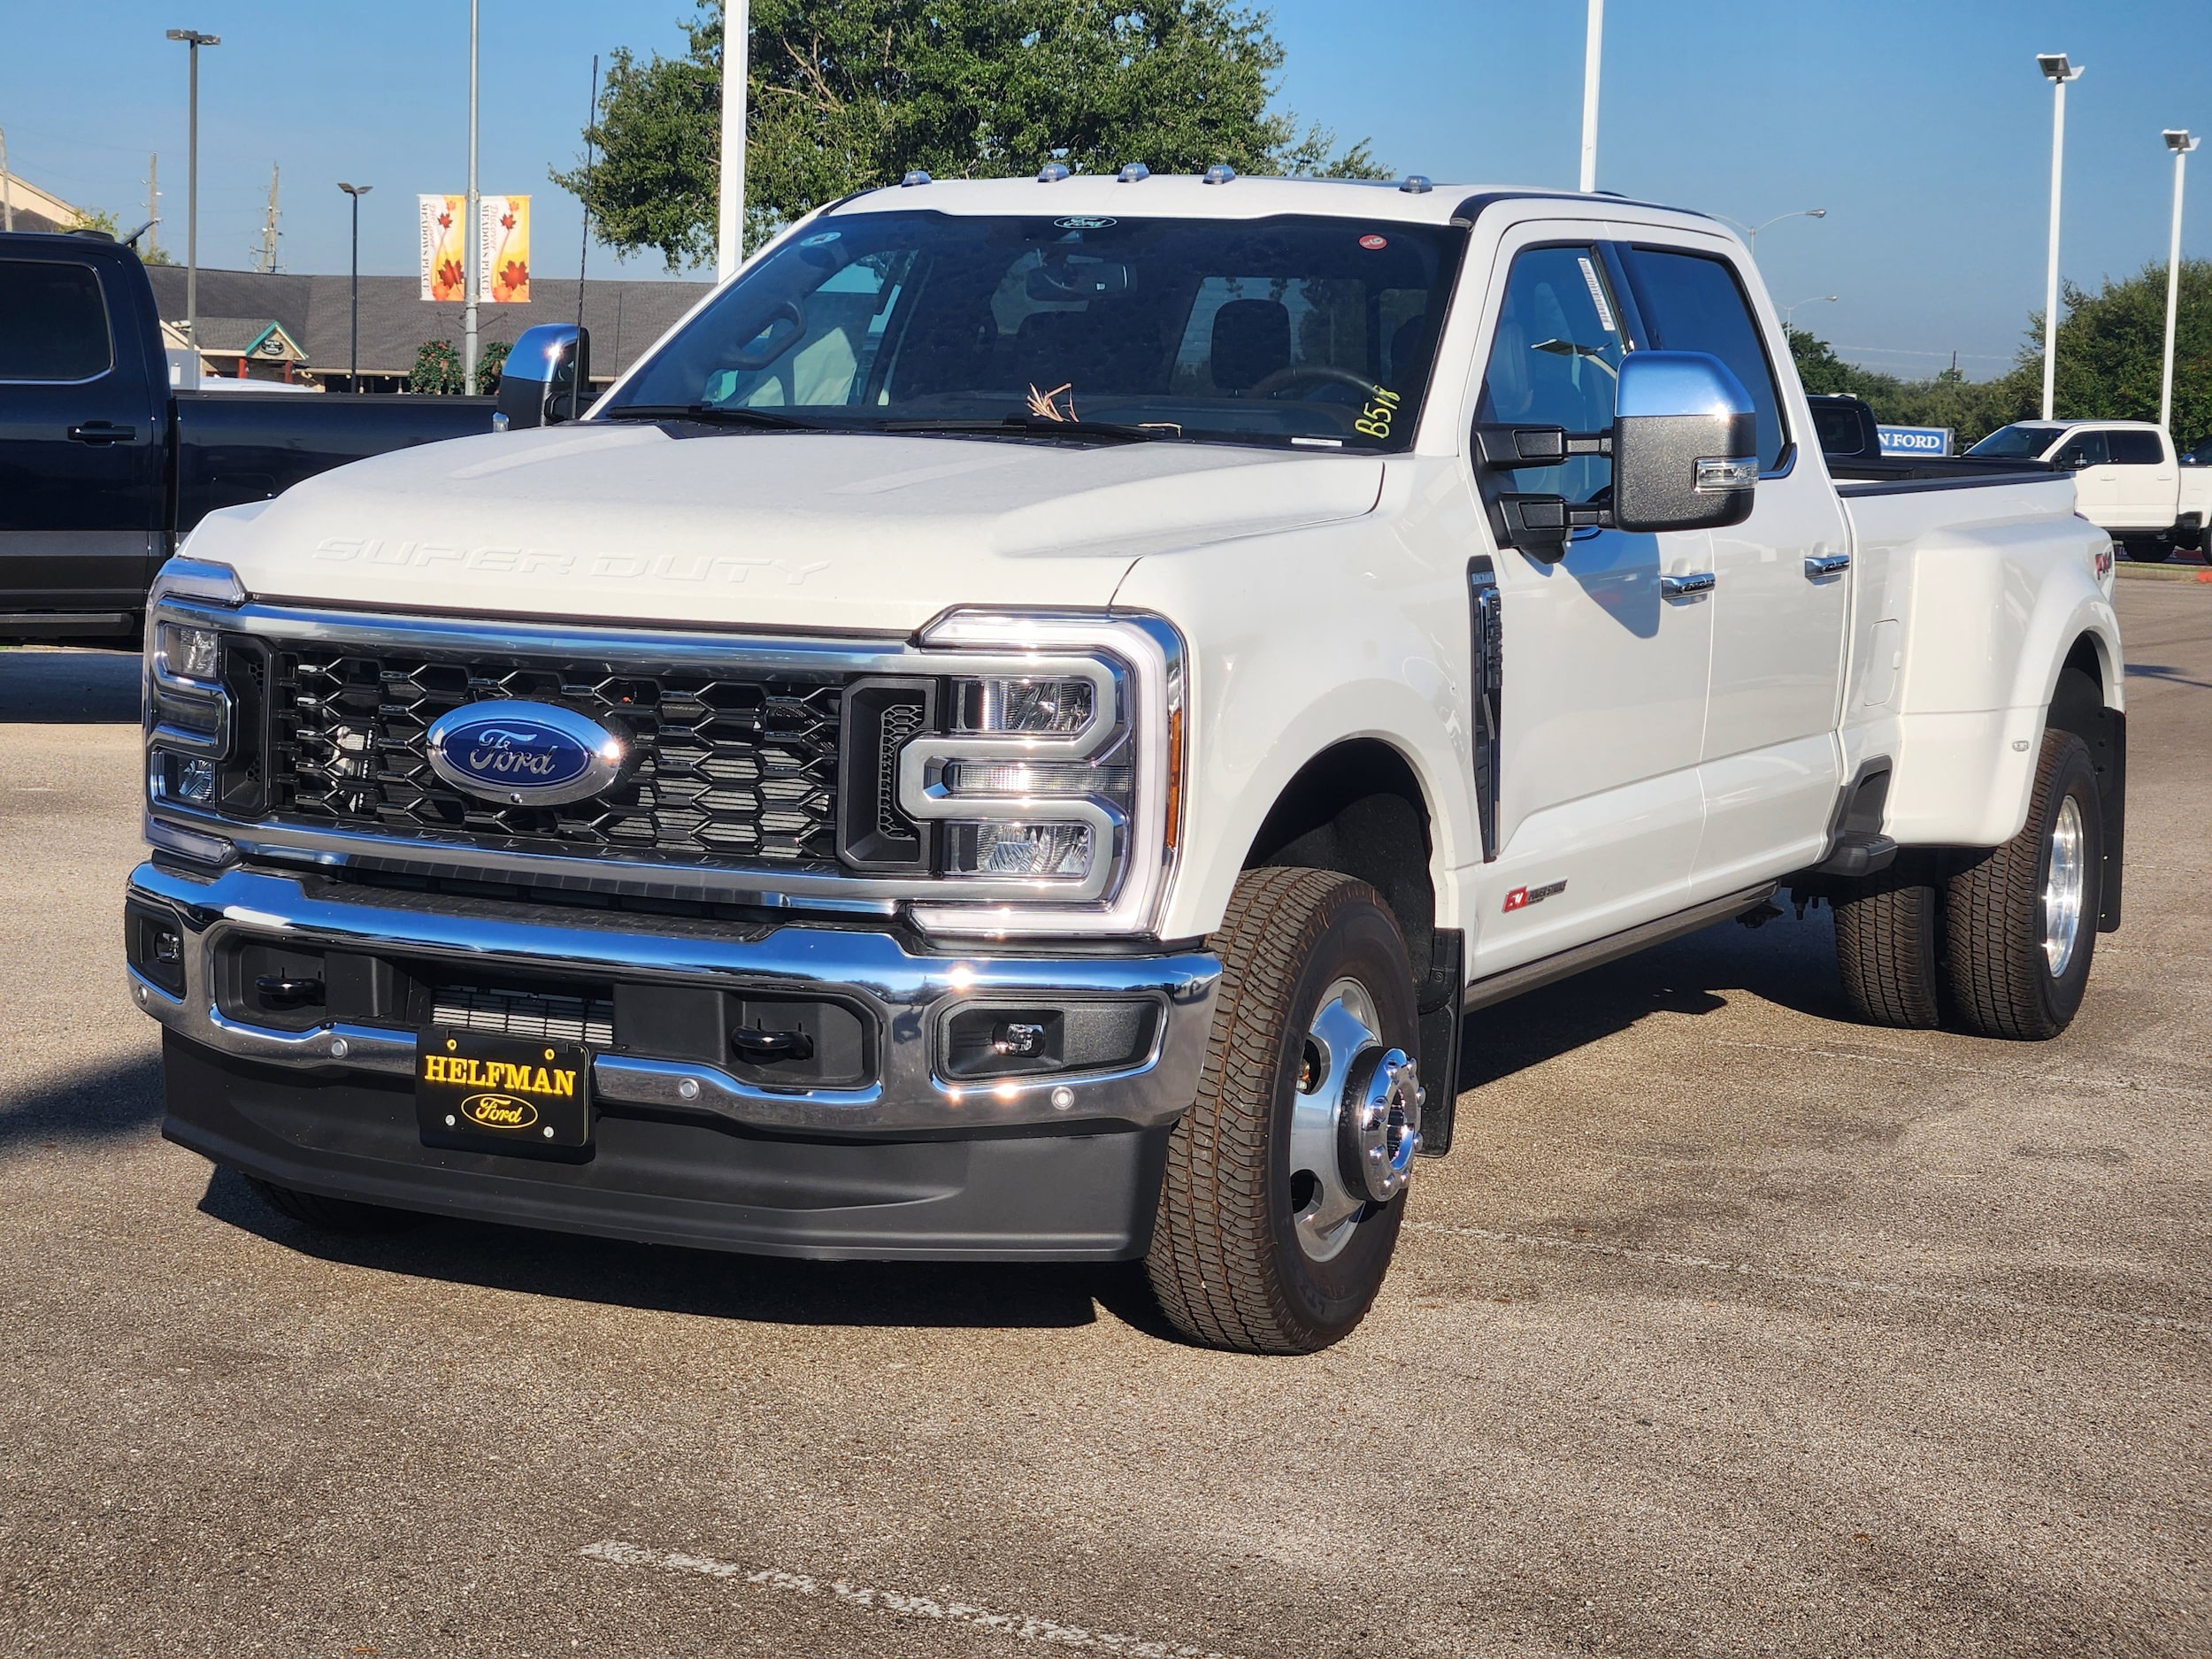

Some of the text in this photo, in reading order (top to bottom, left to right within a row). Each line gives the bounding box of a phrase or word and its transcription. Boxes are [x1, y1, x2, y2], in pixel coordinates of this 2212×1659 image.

[489, 204, 498, 250] Discover
[1063, 217, 1108, 227] Ford
[1354, 384, 1401, 439] B518
[1893, 434, 1940, 449] FORD
[311, 536, 832, 586] SUPER DUTY
[469, 728, 559, 776] Ford
[424, 1055, 577, 1096] HELFMAN
[475, 1096, 524, 1124] Ford
